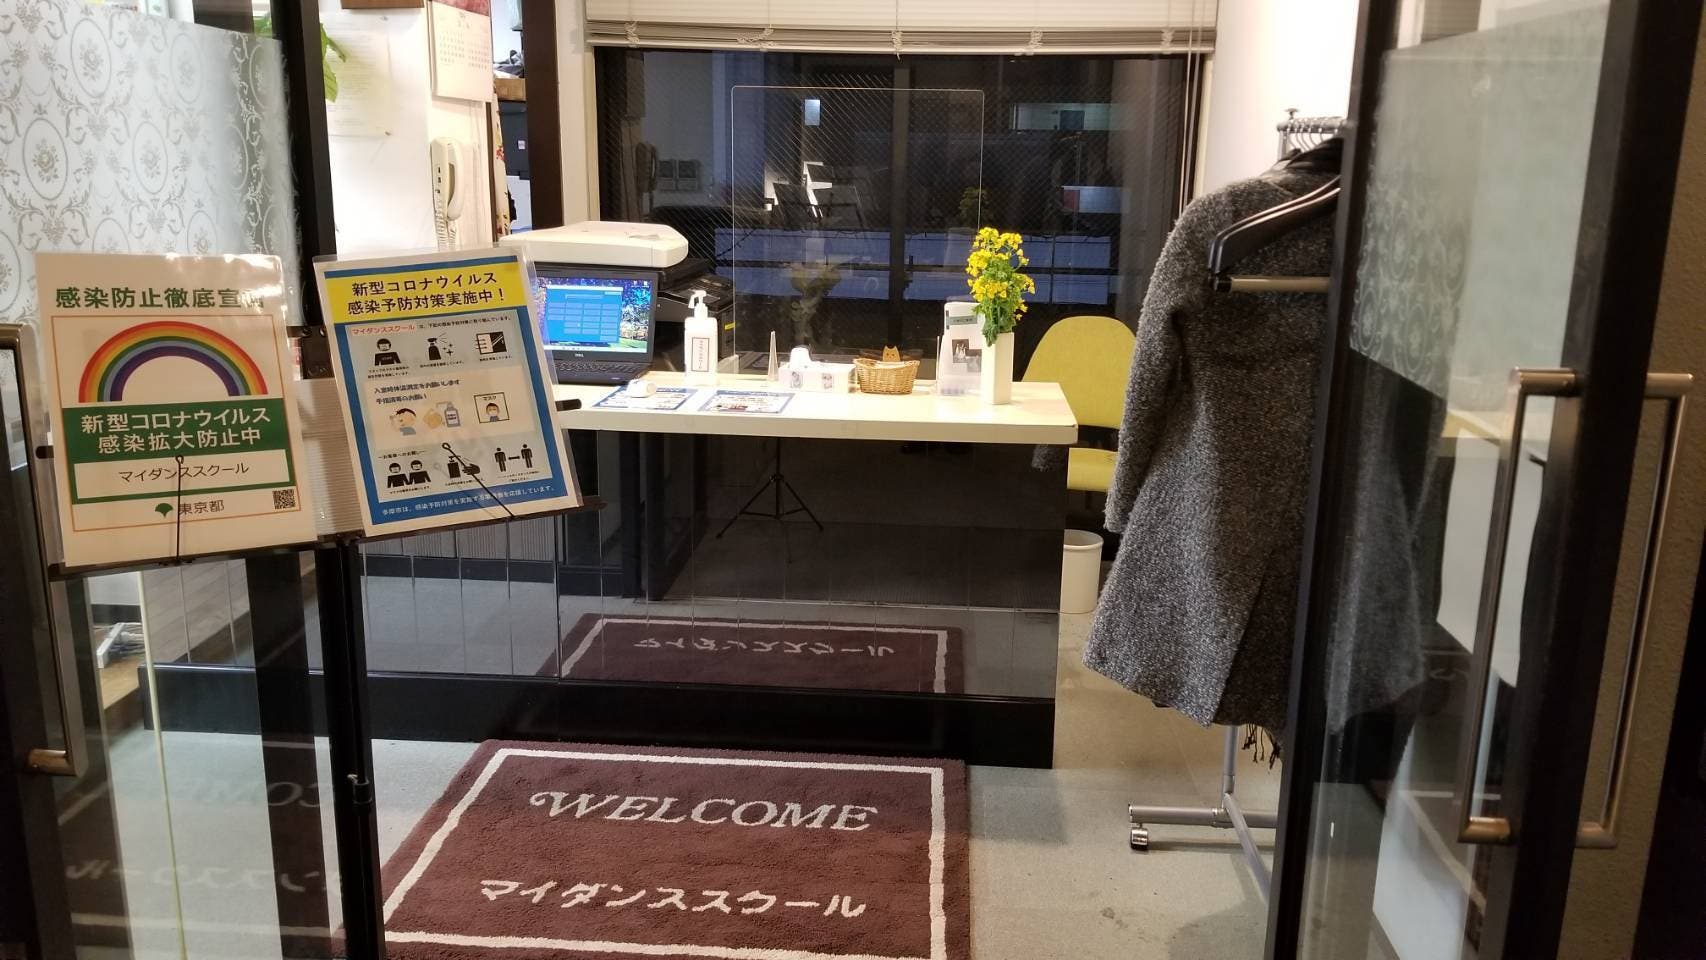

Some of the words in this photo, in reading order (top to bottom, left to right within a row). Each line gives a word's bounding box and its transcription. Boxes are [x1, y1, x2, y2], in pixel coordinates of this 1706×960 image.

[352, 272, 498, 297] 新型コロナウイルス
[352, 324, 416, 334] マイダンススクール
[81, 407, 271, 434] 新型コロナウイルス
[98, 427, 261, 454] 感染拡大防止中
[118, 462, 249, 482] マイダンススクール
[179, 499, 225, 515] 東京都
[530, 791, 878, 832] WELCOME
[480, 879, 866, 918] マイダンススクール
